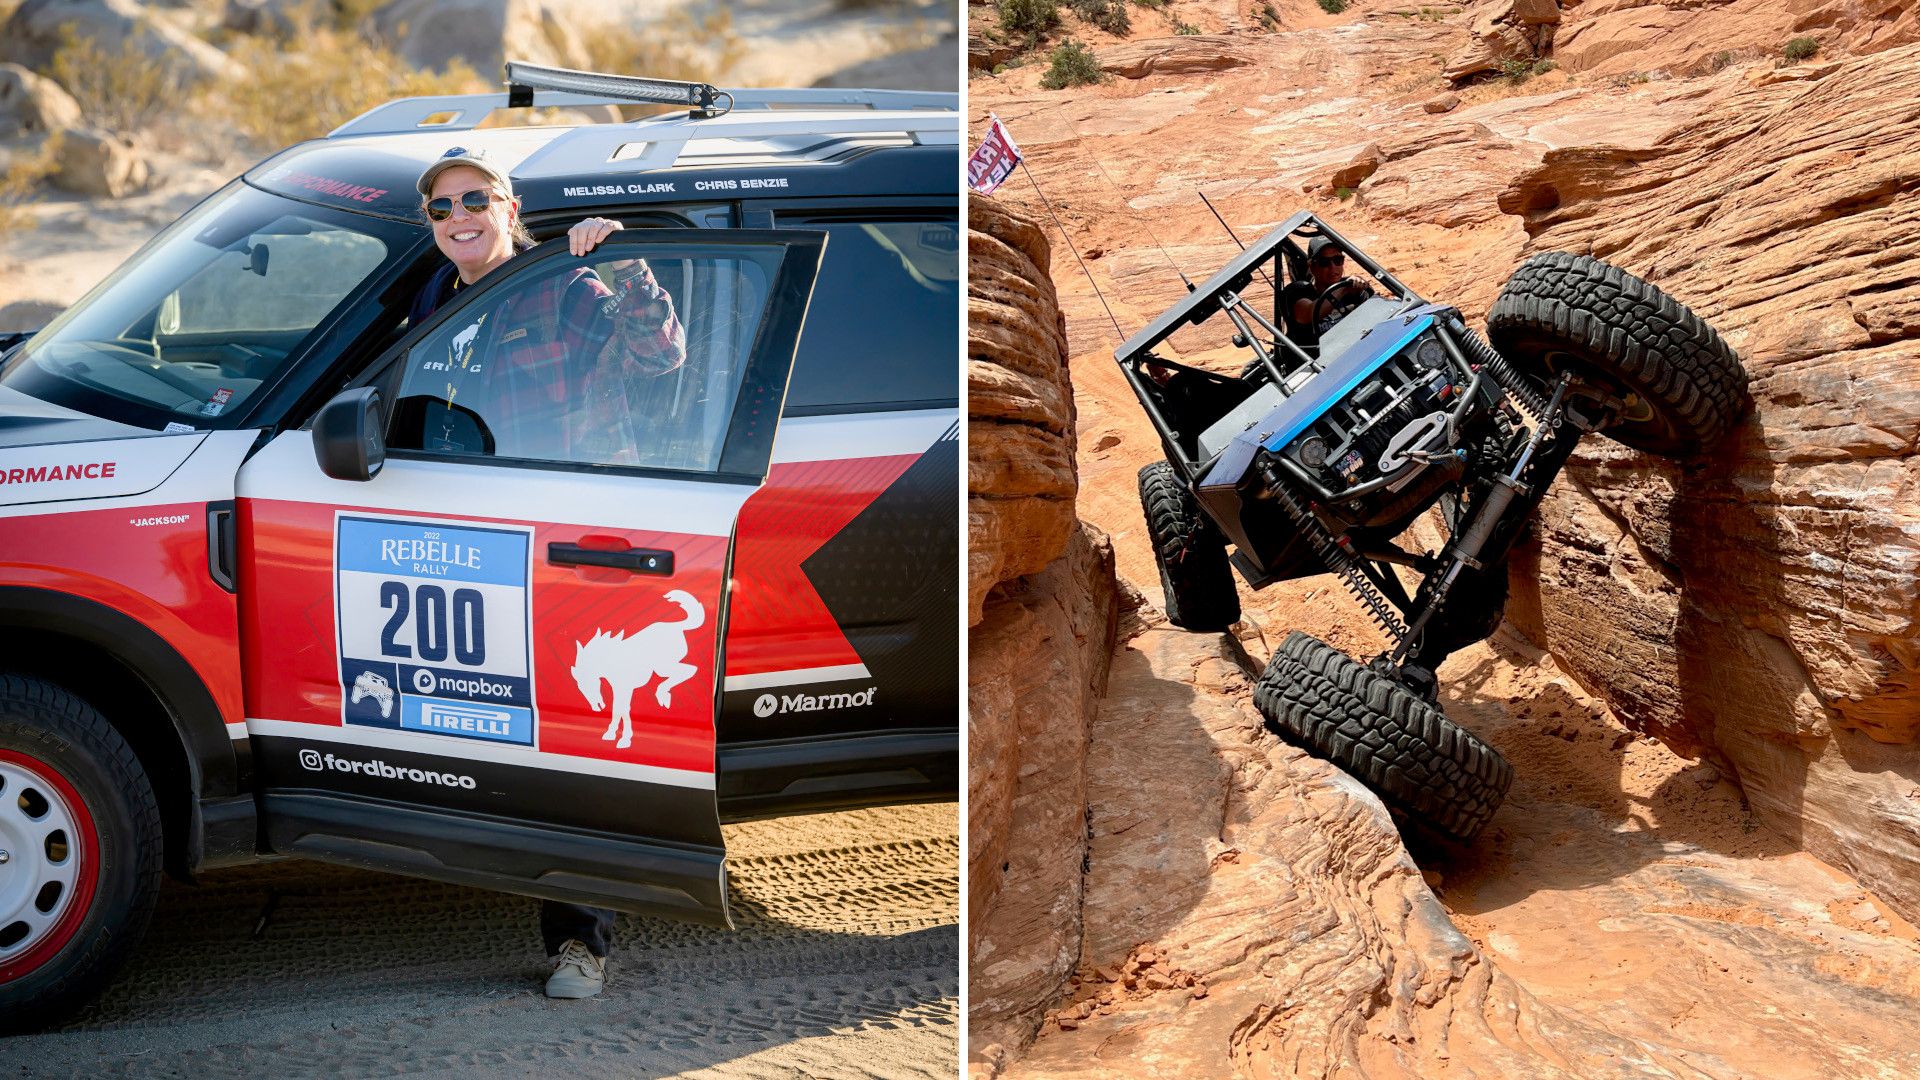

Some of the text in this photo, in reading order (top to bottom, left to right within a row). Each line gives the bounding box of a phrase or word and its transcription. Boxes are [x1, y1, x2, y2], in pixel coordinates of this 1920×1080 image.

[564, 183, 676, 197] MELISSA CLARK
[695, 178, 789, 191] CHRIS BENZIE
[423, 531, 440, 540] 2022
[381, 539, 481, 570] REBELLE
[413, 563, 449, 575] RALLY
[380, 580, 486, 666] 200
[440, 677, 513, 698] mapbox
[779, 687, 877, 714] Marmot
[421, 702, 511, 736] PIRELLI
[324, 753, 477, 790] fordbronco
